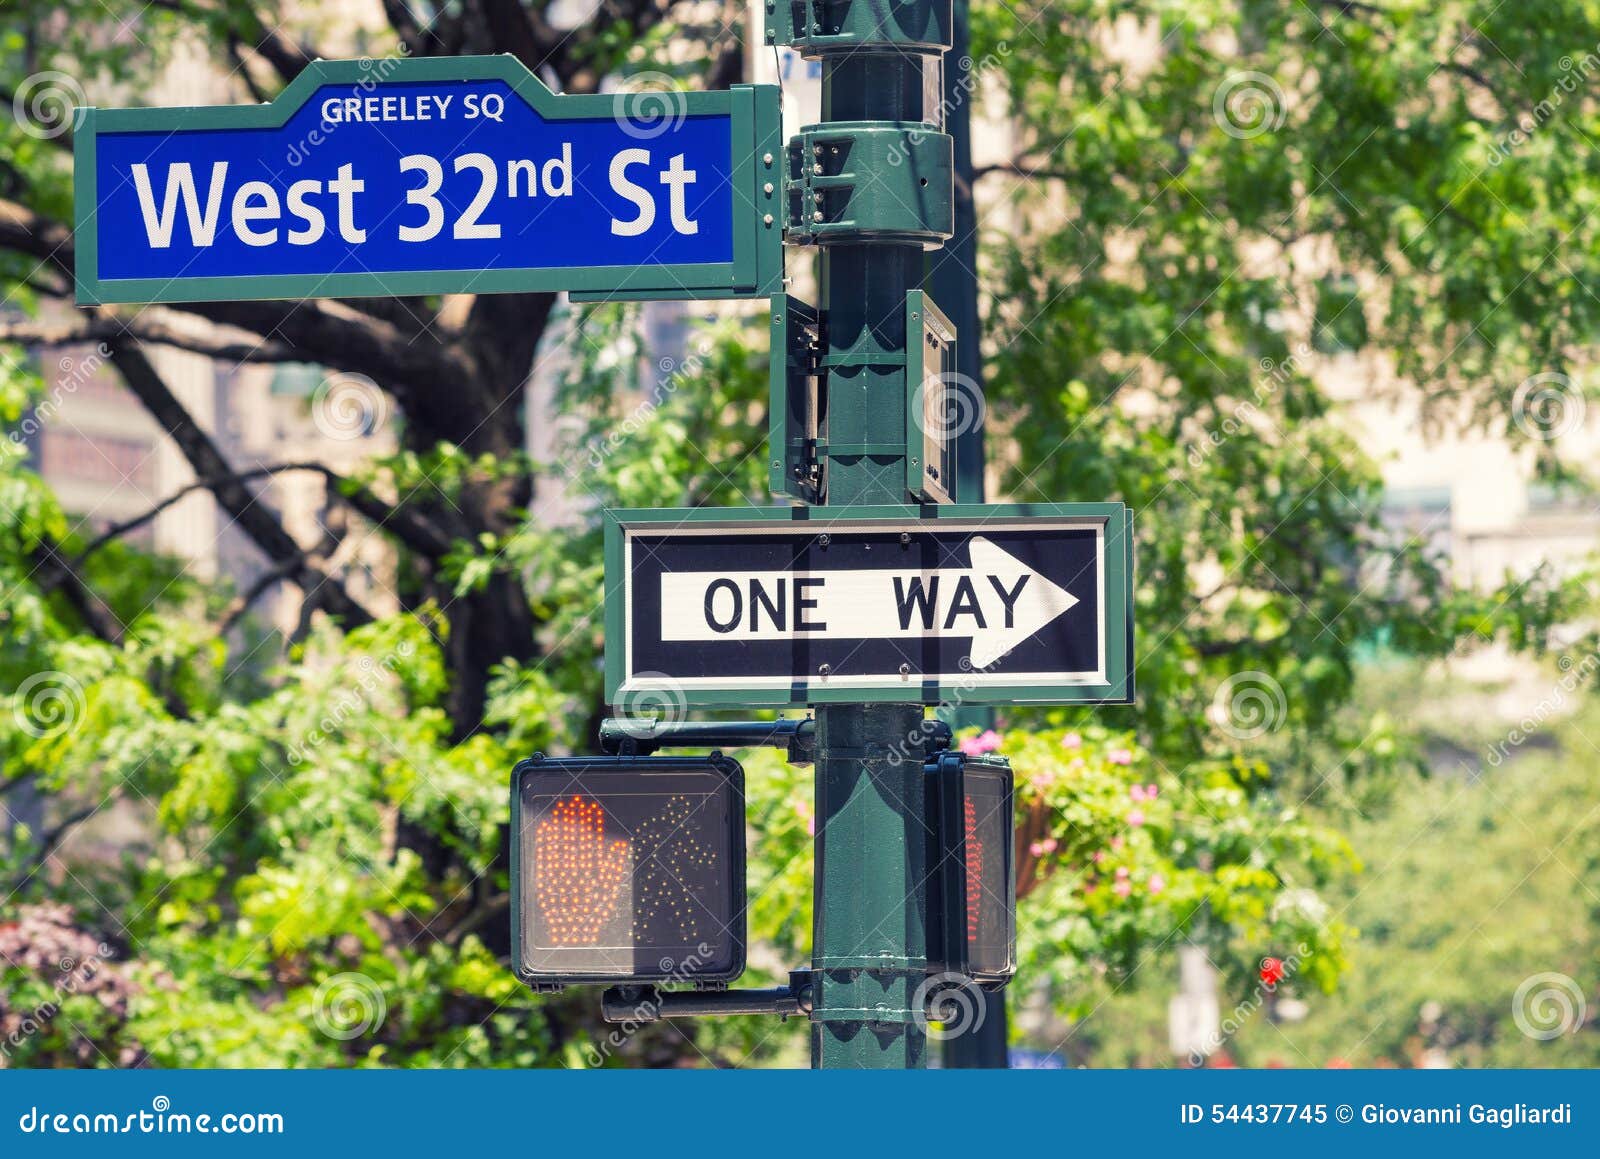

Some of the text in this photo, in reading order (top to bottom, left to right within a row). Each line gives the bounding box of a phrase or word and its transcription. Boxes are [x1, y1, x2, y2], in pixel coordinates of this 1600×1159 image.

[321, 93, 505, 124] GREELEY SQ
[131, 142, 699, 249] West 32nd St
[703, 574, 1032, 634] ONE WAY
